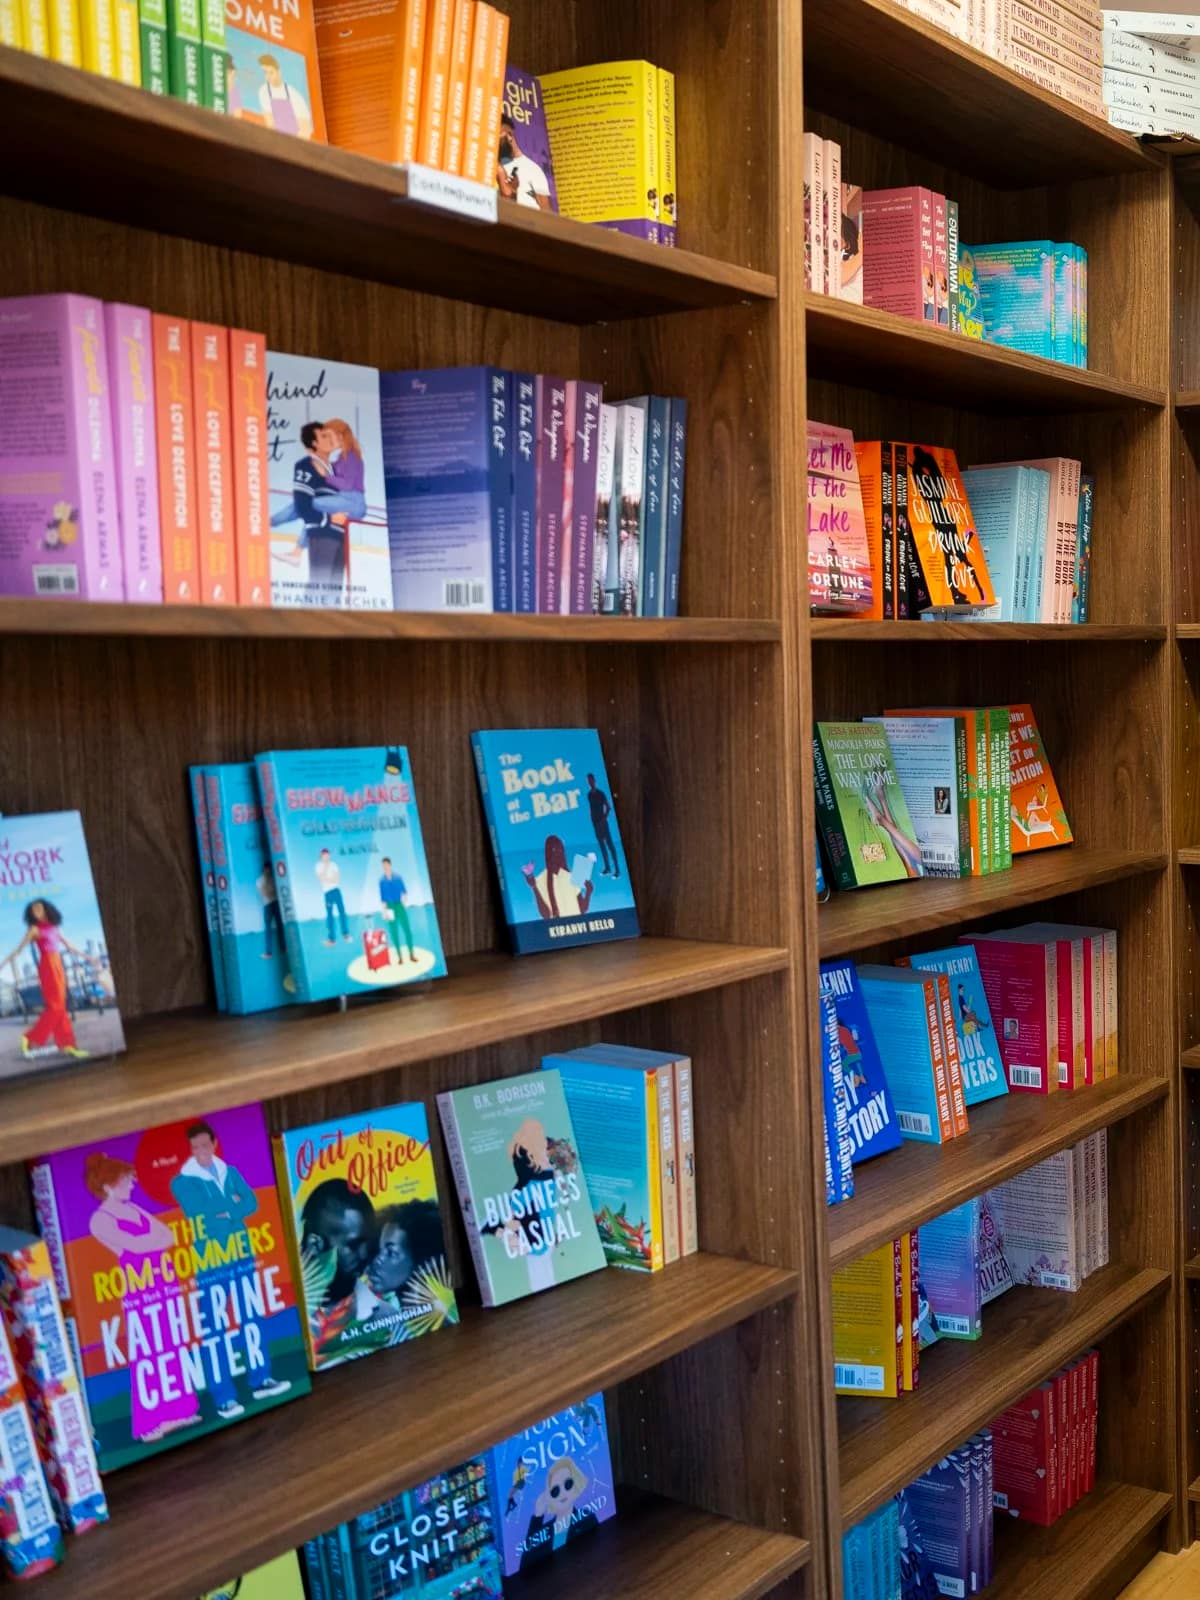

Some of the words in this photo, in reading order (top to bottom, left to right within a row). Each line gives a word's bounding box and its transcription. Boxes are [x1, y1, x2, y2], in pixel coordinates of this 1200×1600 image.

[1013, 26, 1018, 35] IT
[1018, 28, 1035, 45] ENDS
[1035, 37, 1050, 53] WITH
[1050, 47, 1059, 58] US
[506, 78, 539, 109] girl
[948, 218, 958, 293] OUTDRAWN
[207, 411, 220, 448] LOVE
[831, 443, 853, 472] Me
[208, 452, 224, 533] DECEPTION
[823, 478, 847, 498] the
[910, 473, 963, 501] JASMINE
[808, 503, 850, 534] Lake
[912, 498, 970, 525] GUILLORY
[928, 530, 975, 553] DRUNK
[807, 552, 857, 570] CARLEY
[944, 566, 977, 589] LOVE
[499, 753, 522, 766] The
[834, 753, 859, 770] THE
[859, 752, 888, 768] LONG
[502, 758, 575, 795] Book
[835, 772, 863, 788] WAY
[864, 769, 897, 786] HOME
[286, 782, 411, 812] SHOWMANCE
[506, 799, 520, 812] at
[531, 788, 581, 818] Bar
[509, 810, 530, 825] the
[499, 1080, 546, 1104] BORISON
[358, 1123, 373, 1148] of
[296, 1128, 345, 1182] Out
[347, 1137, 431, 1198] Office
[483, 1173, 581, 1228] BUSINESS
[167, 1214, 207, 1246] THE
[501, 1212, 581, 1259] CASUAL
[92, 1222, 275, 1303] ROM-COMMERS
[100, 1265, 285, 1369] KATHERINE
[340, 1328, 363, 1342] A.H.
[363, 1304, 433, 1334] CUNNINGHAM
[136, 1322, 265, 1410] CENTER
[521, 1426, 587, 1477] SIGN
[369, 1495, 469, 1557] CLOSE
[514, 1526, 552, 1558] SUSIE
[553, 1495, 609, 1535] DUMOND
[388, 1529, 459, 1581] KNIT
